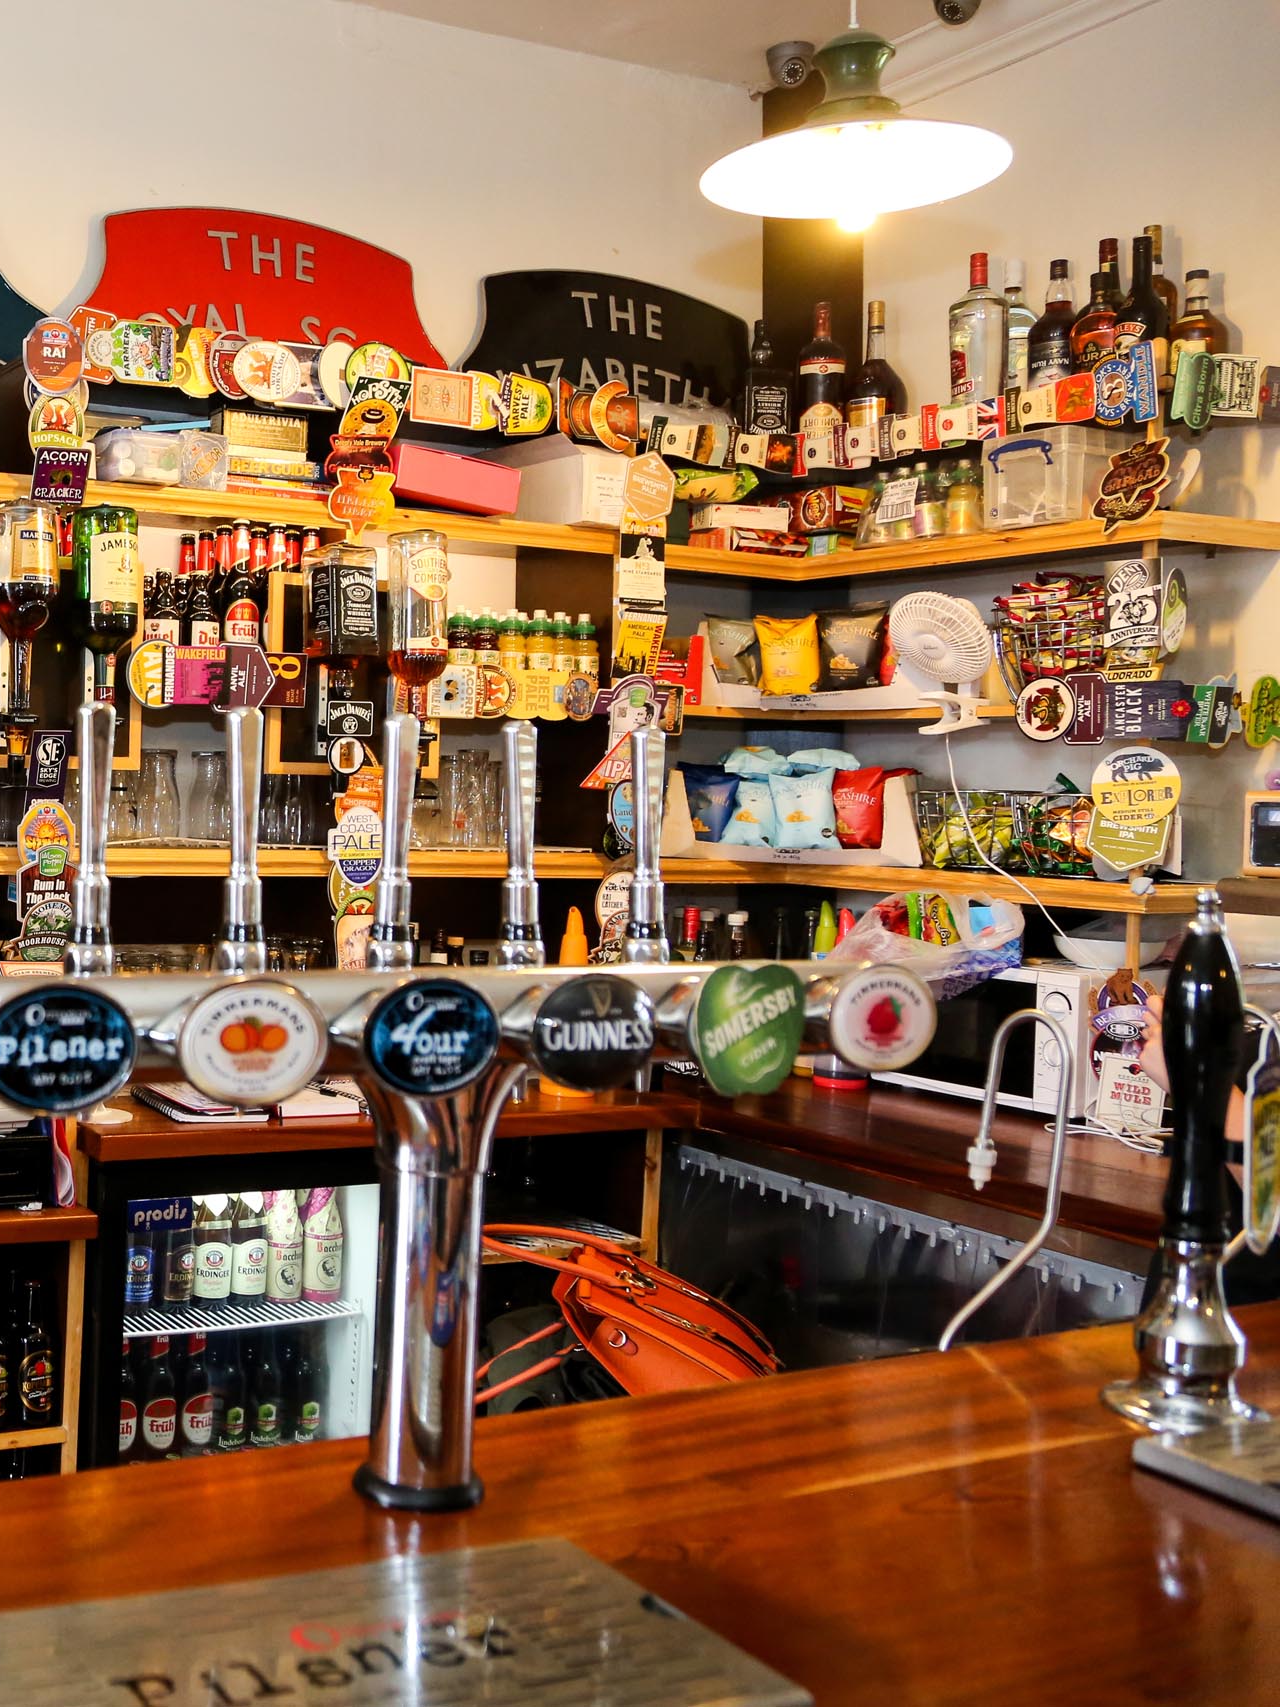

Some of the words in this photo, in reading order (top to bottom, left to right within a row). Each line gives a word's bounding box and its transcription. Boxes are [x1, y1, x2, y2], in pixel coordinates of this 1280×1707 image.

[207, 229, 317, 283] THE
[570, 290, 663, 341] THE
[43, 346, 66, 359] RAI
[1135, 345, 1150, 417] WANDLE
[351, 380, 405, 411] HOPSTER
[513, 381, 524, 429] HARVEST
[520, 394, 529, 420] PALE
[1192, 393, 1204, 425] Citra
[232, 411, 302, 428] ADULTRIVIA
[33, 433, 78, 447] HOPSACK
[39, 451, 89, 462] ACORN
[230, 459, 269, 473] BEER
[271, 461, 314, 477] GUIDE
[34, 486, 83, 499] CRACKER
[1114, 562, 1143, 592] DENT
[624, 612, 668, 624] FERNANDES
[231, 624, 257, 639] früh
[627, 623, 654, 632] AMERICAN
[1109, 626, 1158, 642] ANNIVERSARY
[175, 648, 226, 660] WAKEFIELD
[646, 625, 663, 676] WAKEFIELD
[164, 646, 175, 703] FERNANDES
[230, 665, 239, 692] ANVIL
[238, 670, 246, 688] ALE
[465, 667, 475, 717] ACORN
[525, 675, 537, 712] PALE
[538, 675, 550, 712] REET
[330, 707, 349, 720] JACK
[349, 706, 371, 722] DANIEL'S
[1114, 684, 1126, 737] LANCASTER
[1126, 687, 1143, 733] BLACK
[604, 759, 633, 778] IPA
[1110, 755, 1154, 771] ORCHARD
[1123, 763, 1143, 773] PIG
[344, 798, 377, 808] CHOPPER
[1101, 787, 1174, 806] EXPLORER
[347, 814, 373, 824] WEST
[1112, 813, 1143, 822] CIDER
[339, 823, 380, 833] COAST
[1119, 830, 1135, 840] IPA
[332, 834, 381, 850] PALE
[343, 865, 377, 873] DRAGON
[33, 878, 52, 891] Rum
[53, 878, 65, 891] In
[203, 994, 306, 1038] TIMMERMANS
[702, 982, 799, 1057] SOMERSBY
[543, 1017, 654, 1054] GUINNESS
[740, 1038, 778, 1067] CIDER
[1113, 1081, 1151, 1095] WILD
[1110, 1090, 1152, 1106] MULE
[134, 1202, 189, 1228] prodis
[195, 1267, 230, 1280] ERDINGER
[149, 1420, 175, 1434] früh
